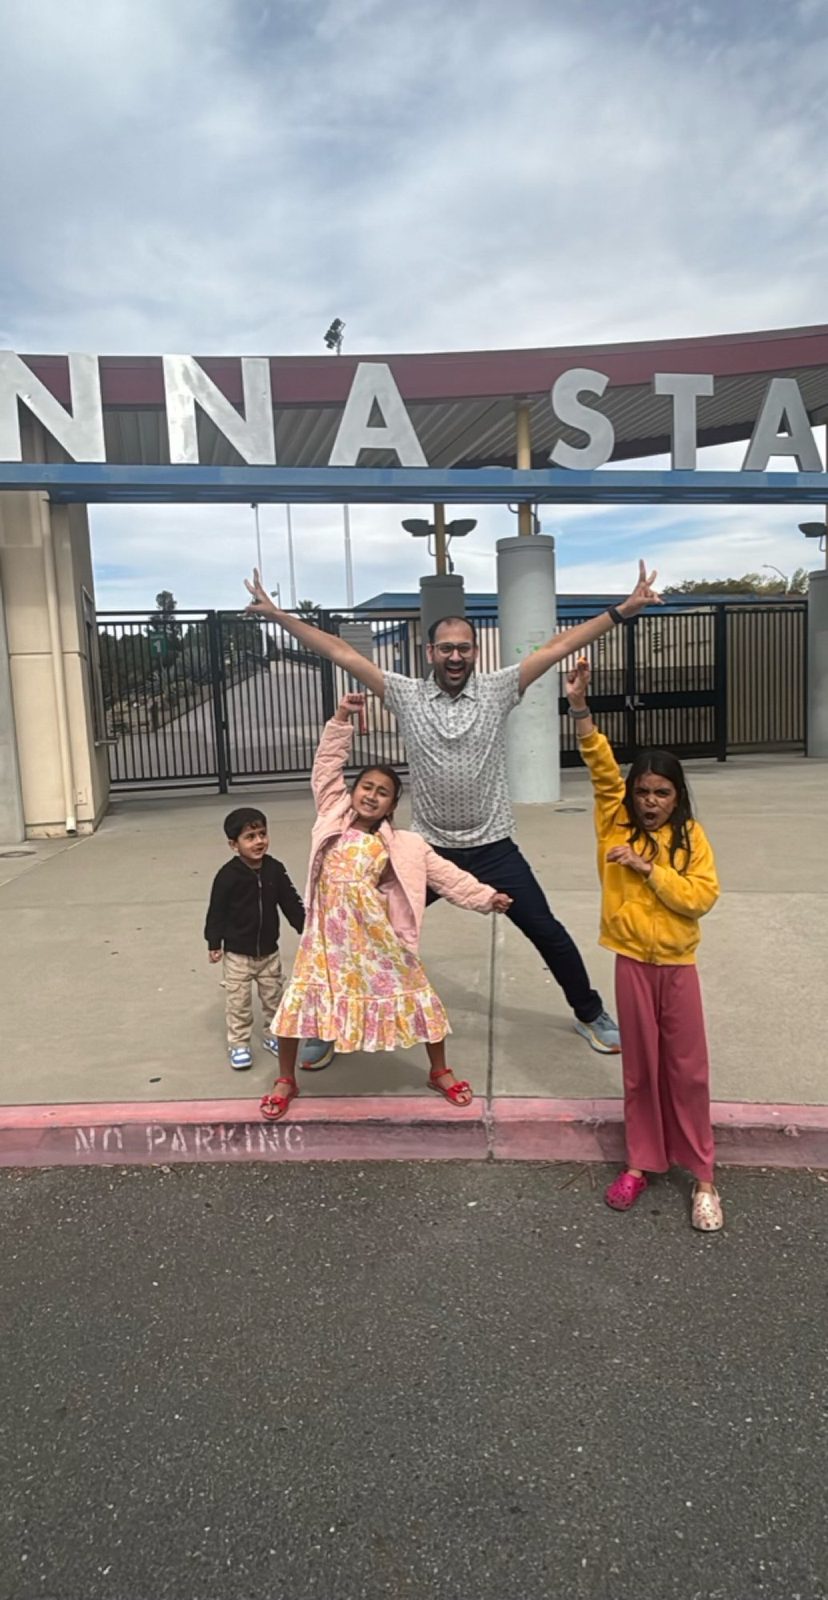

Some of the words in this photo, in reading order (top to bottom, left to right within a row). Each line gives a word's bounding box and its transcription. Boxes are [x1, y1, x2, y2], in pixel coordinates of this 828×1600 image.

[0, 350, 428, 466] NNA
[549, 367, 823, 471] STA
[75, 1126, 124, 1154] NO
[146, 1124, 304, 1153] PARKING
